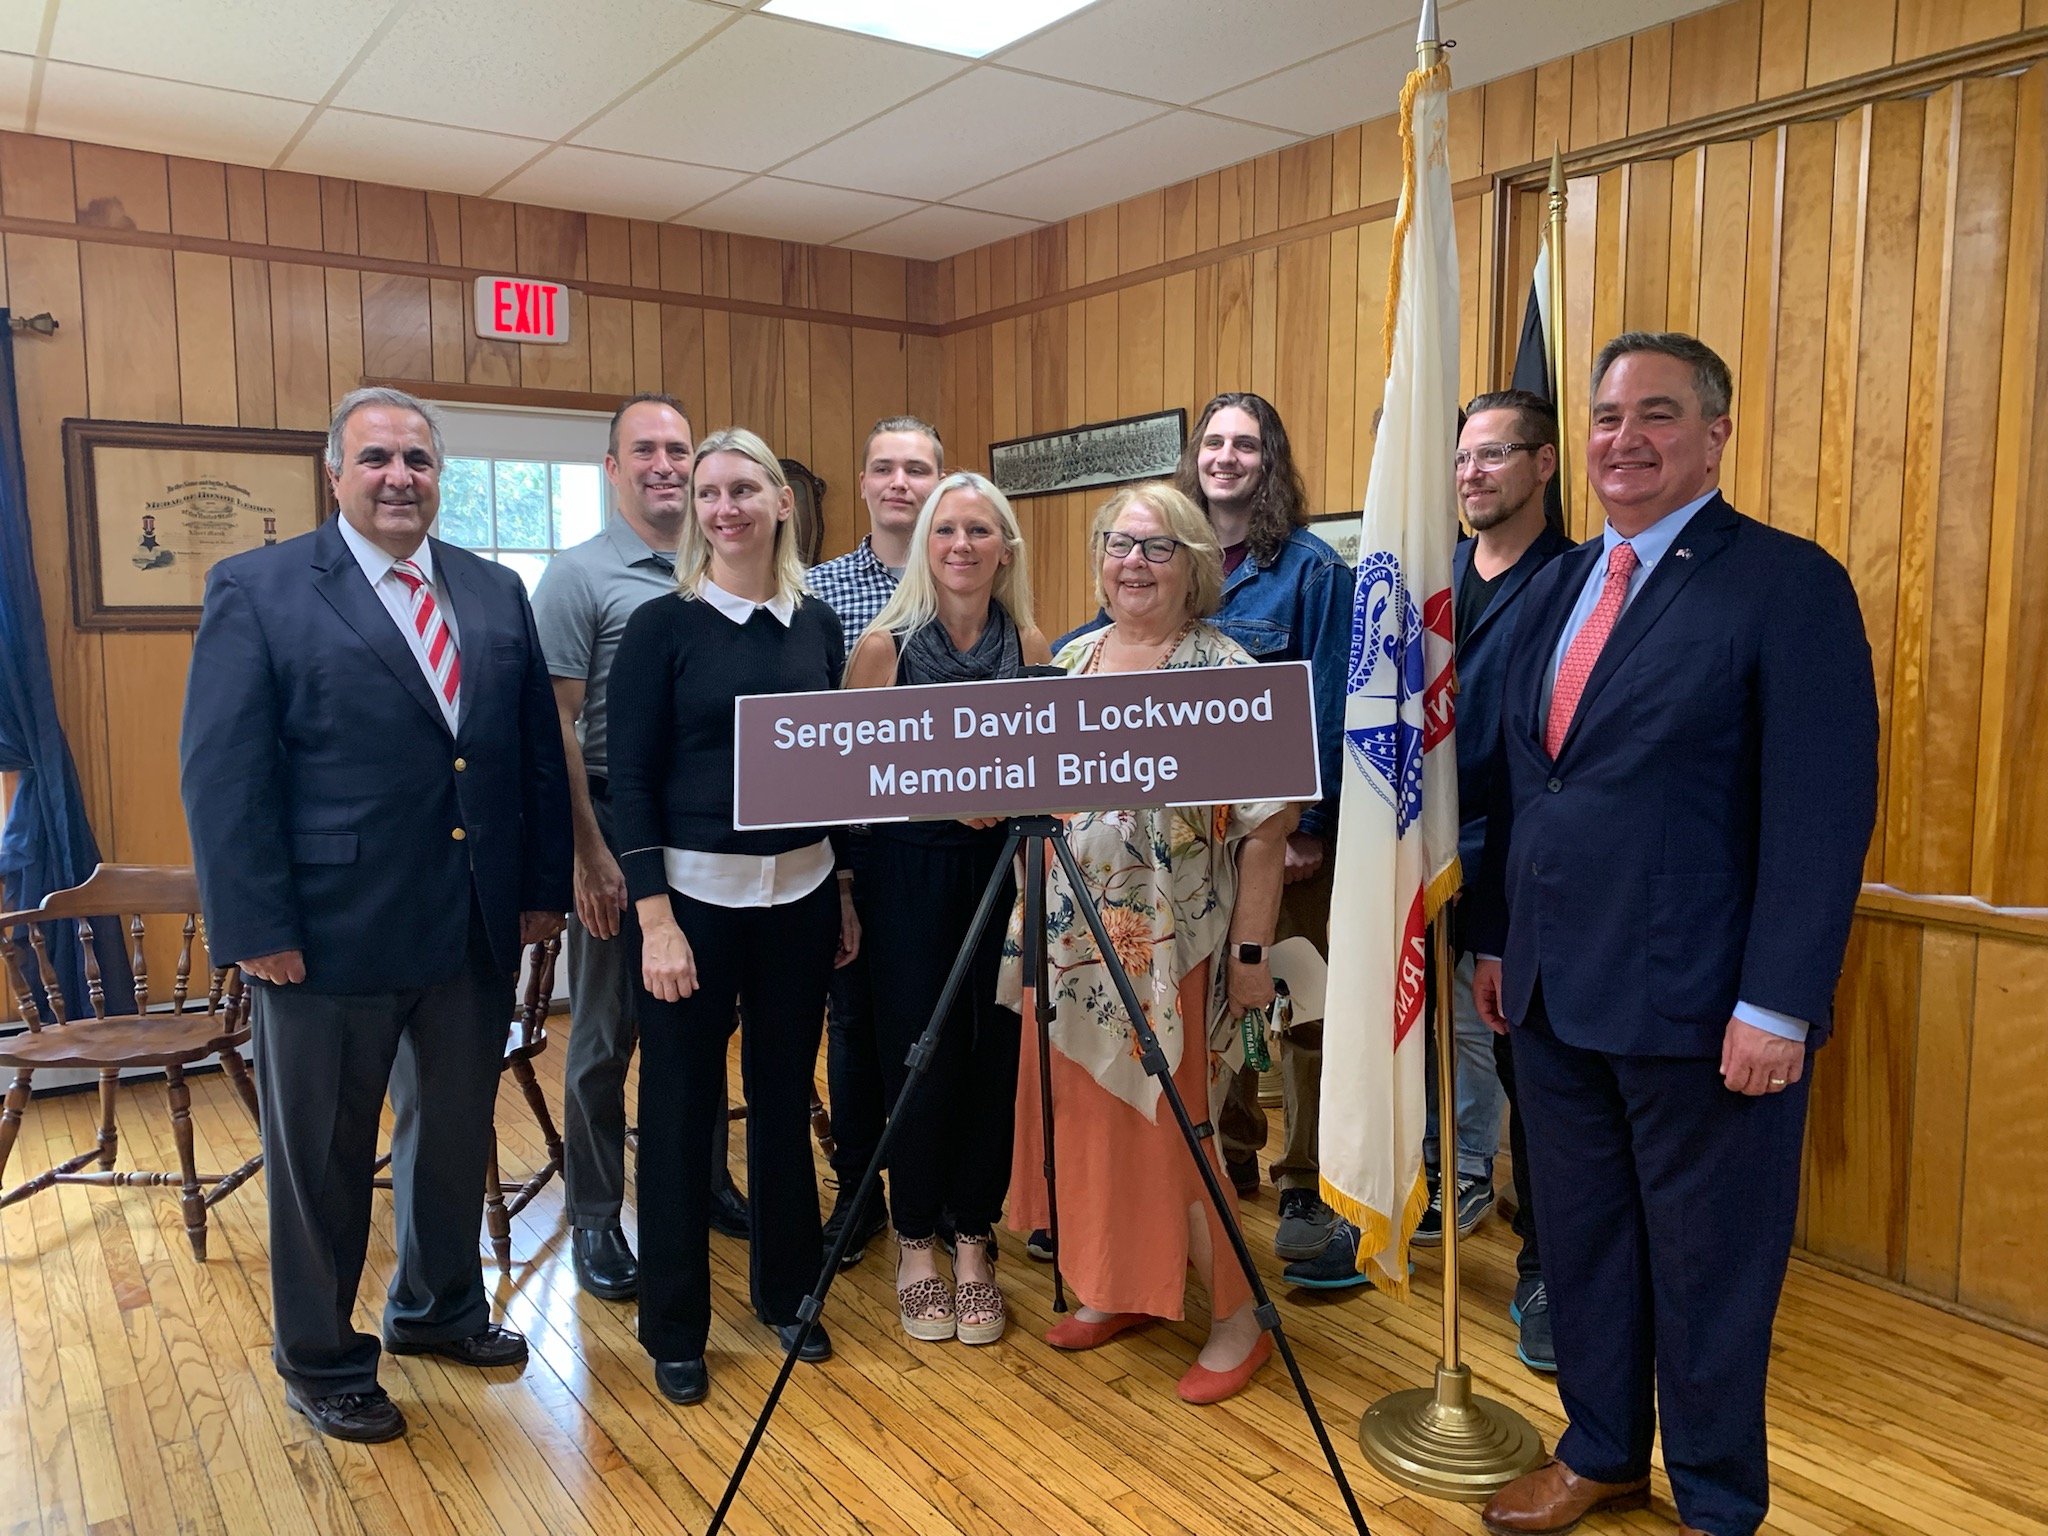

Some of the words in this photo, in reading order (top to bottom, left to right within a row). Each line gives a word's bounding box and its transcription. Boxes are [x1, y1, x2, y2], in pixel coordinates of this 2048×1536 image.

[494, 281, 558, 336] EXIT
[198, 491, 235, 503] HONOR
[236, 498, 276, 514] LEGION
[773, 709, 934, 756] Sergeant
[953, 701, 1057, 739] David
[1078, 688, 1273, 732] Lockwood
[869, 755, 1036, 797] Memorial
[1057, 750, 1178, 793] Bridge
